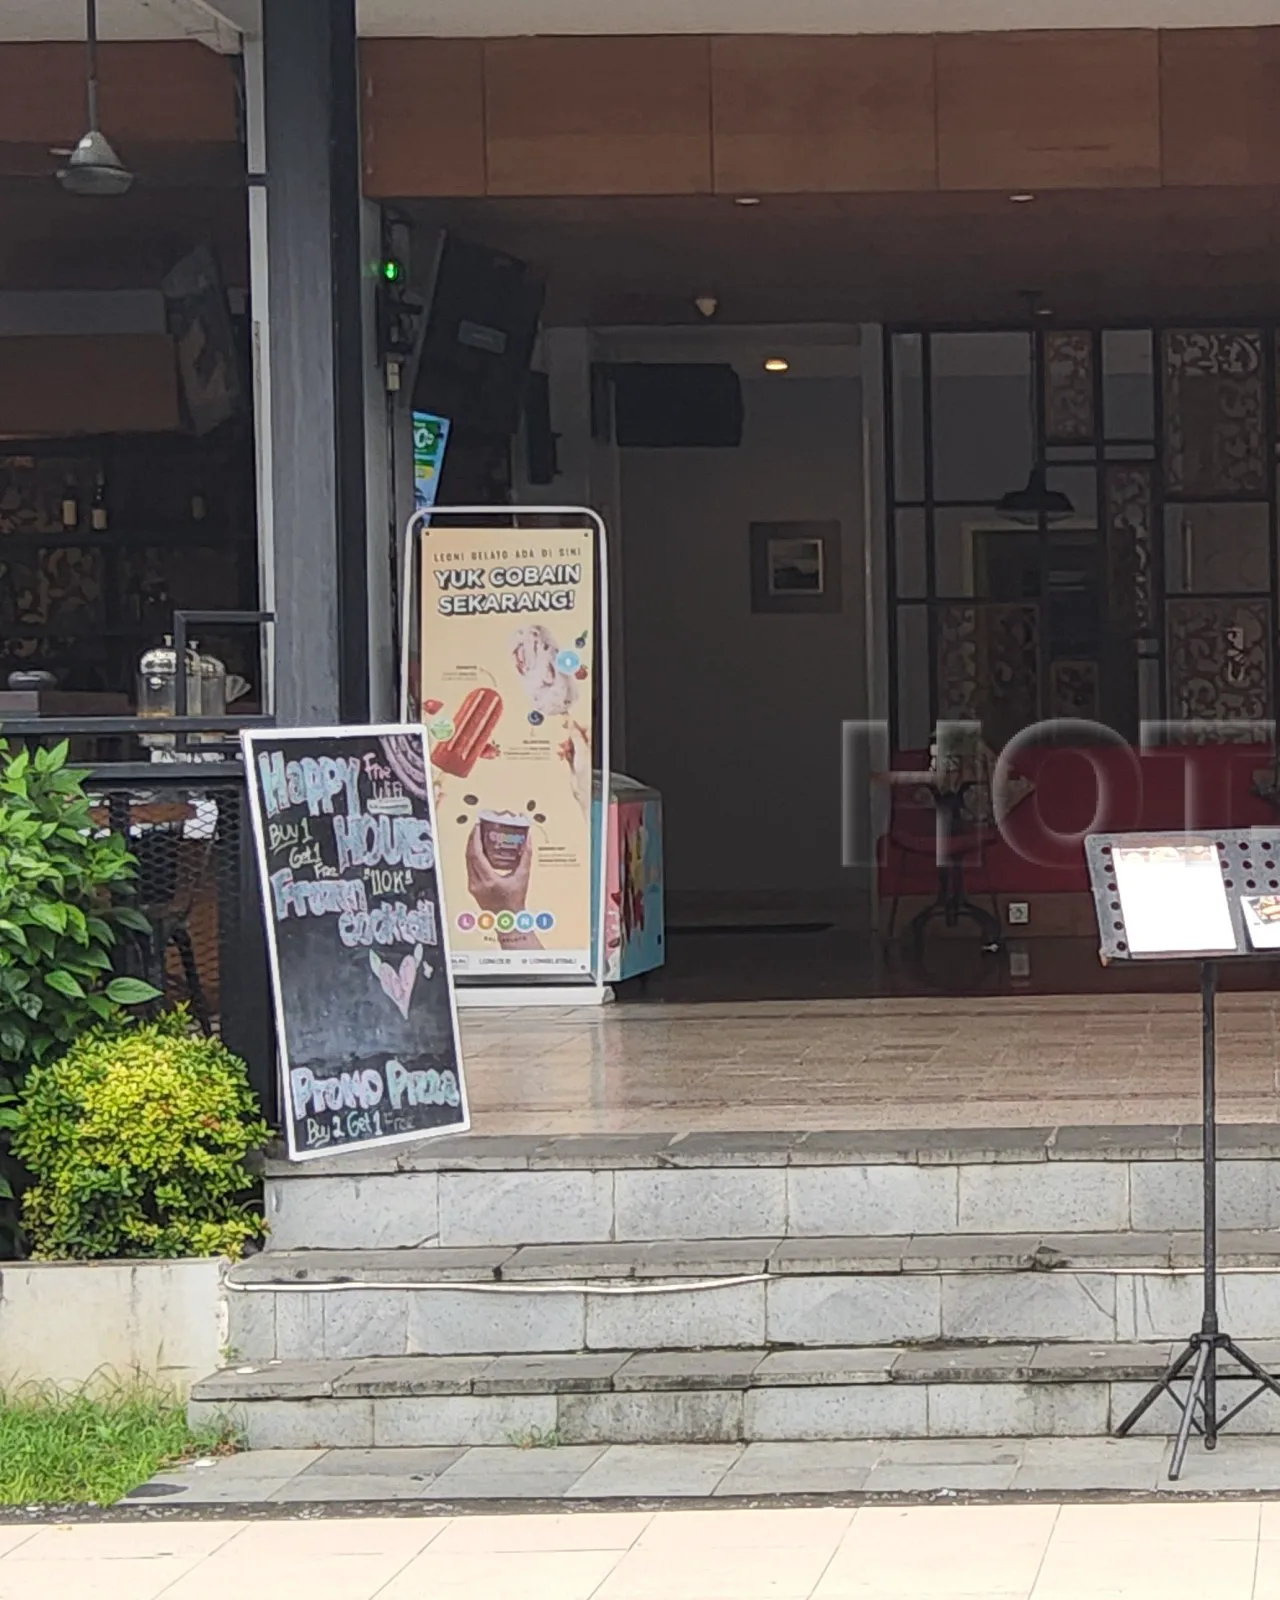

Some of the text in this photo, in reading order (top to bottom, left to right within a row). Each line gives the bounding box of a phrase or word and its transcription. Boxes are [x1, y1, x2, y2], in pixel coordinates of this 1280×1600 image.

[515, 549, 534, 559] ADA
[434, 563, 582, 591] YUK COBAIN
[438, 590, 575, 616] SEKARANG!
[332, 1116, 345, 1138] 2
[373, 1110, 383, 1136] 1
